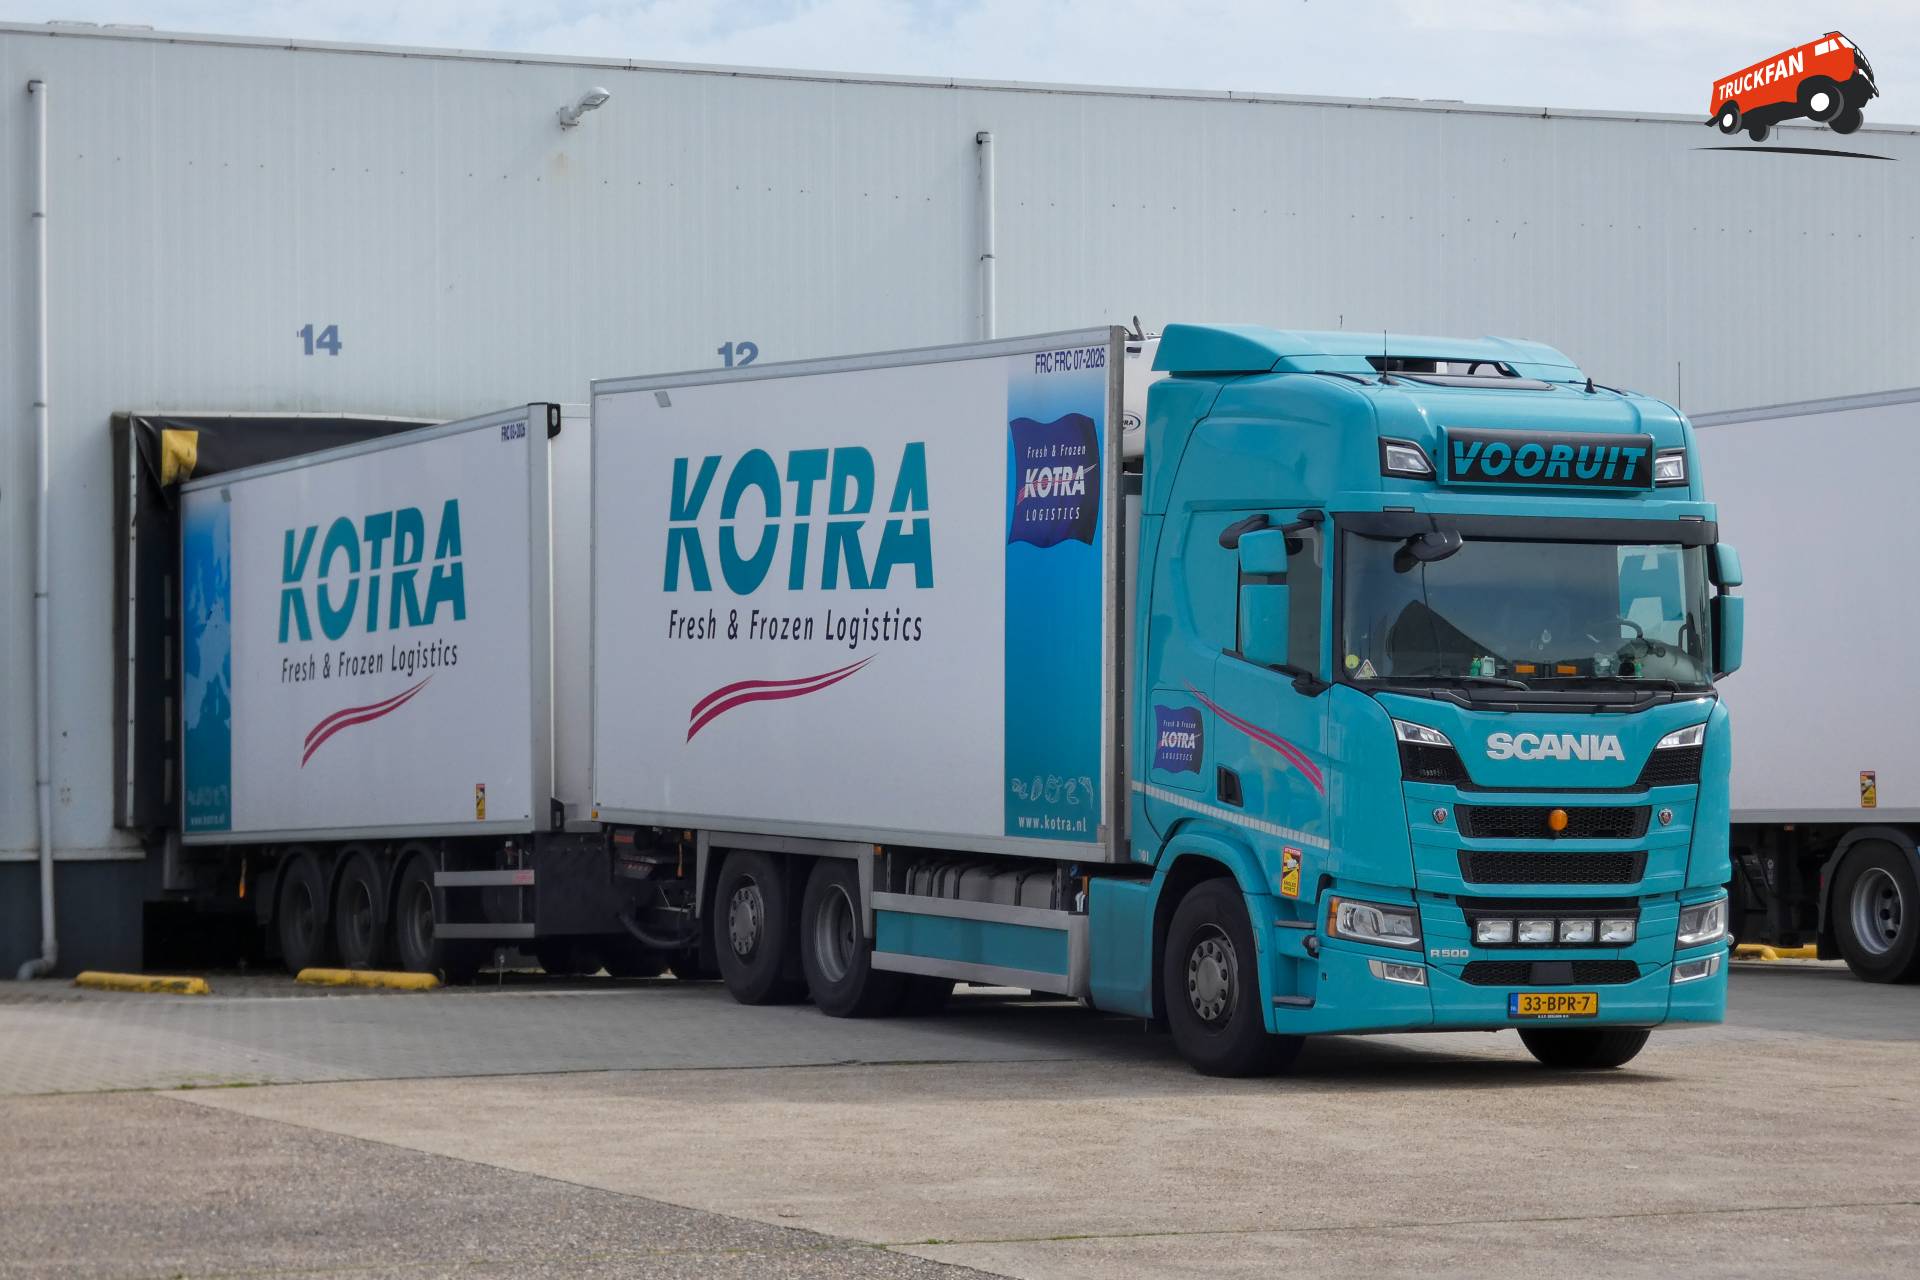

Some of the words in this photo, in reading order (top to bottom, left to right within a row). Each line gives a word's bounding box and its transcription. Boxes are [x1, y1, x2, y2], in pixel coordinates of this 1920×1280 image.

[297, 324, 342, 356] 14
[717, 341, 760, 369] 12
[1035, 353, 1052, 374] FRC
[1055, 350, 1072, 371] FRC
[1073, 347, 1105, 370] 07-2026
[1027, 446, 1048, 459] Fresh
[1051, 444, 1056, 457] &
[1060, 444, 1086, 457] Frozen
[1453, 440, 1647, 481] VOORUIT
[1024, 465, 1085, 498] KOTRA
[663, 441, 935, 597] KOTRA
[1026, 507, 1081, 522] LOGISTICS
[278, 498, 468, 644] KOTRA
[668, 609, 717, 640] Fresh
[727, 609, 739, 640] &
[749, 609, 814, 641] Frozen
[825, 607, 922, 650] Logistics
[281, 653, 315, 683] Fresh
[323, 652, 331, 679] &
[338, 651, 383, 677] Frozen
[391, 641, 457, 677] Logistics
[1161, 731, 1196, 749] KOTRA
[1487, 732, 1626, 761] SCANIA
[1018, 814, 1088, 833] www.kotra.nl
[1523, 996, 1590, 1011] 33-BPR-7
